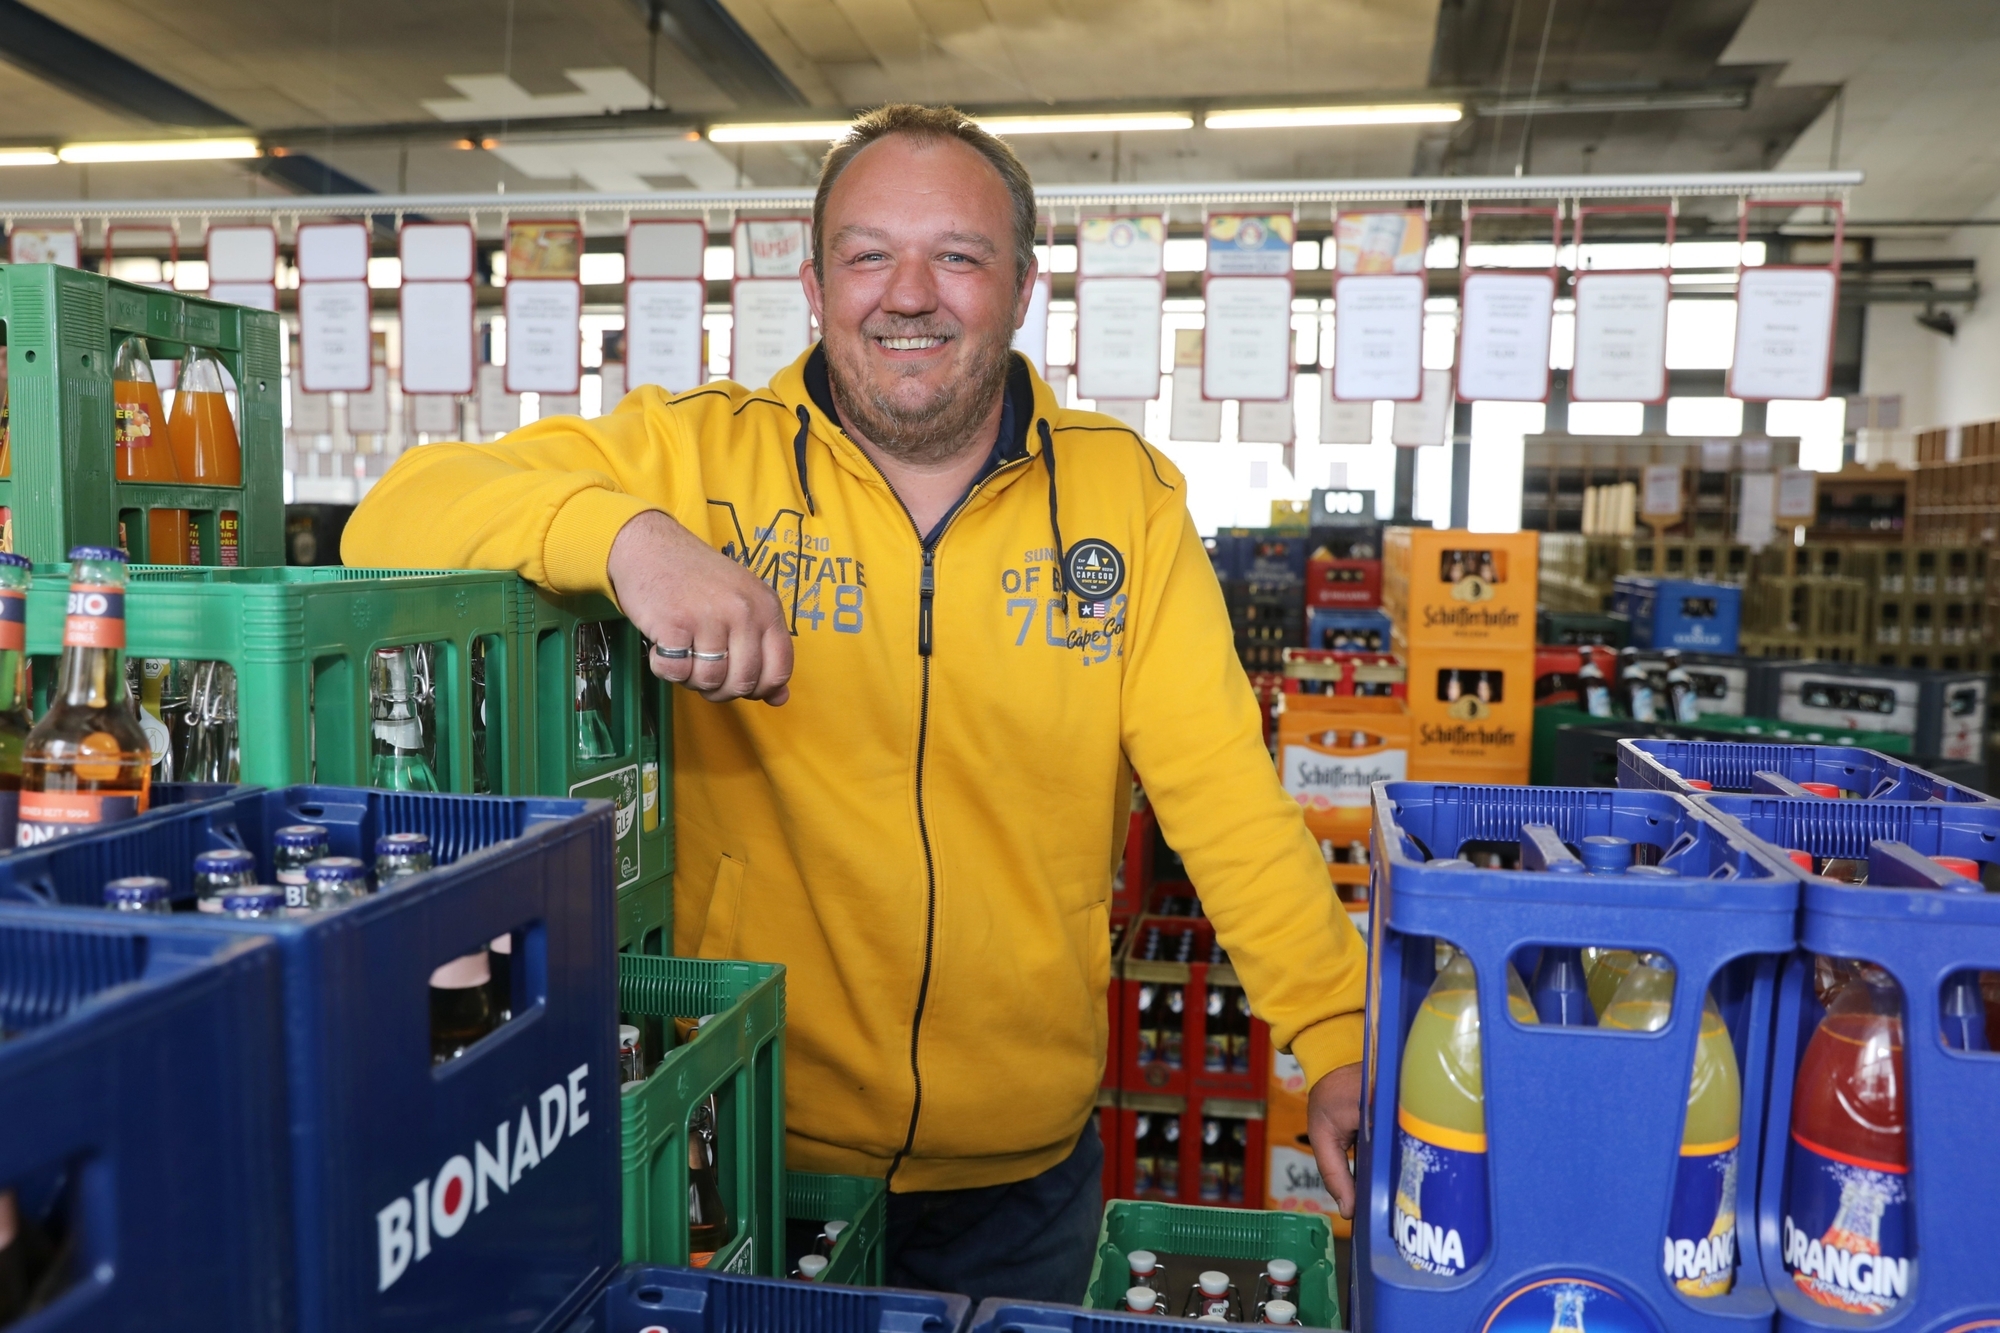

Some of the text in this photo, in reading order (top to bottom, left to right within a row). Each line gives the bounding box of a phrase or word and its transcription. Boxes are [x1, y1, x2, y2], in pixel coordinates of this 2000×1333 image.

[753, 526, 777, 542] MA
[1024, 548, 1060, 563] SUN
[778, 551, 867, 588] STATE
[1002, 567, 1041, 593] OF
[1076, 570, 1113, 580] CAPE COD
[66, 592, 109, 616] BIO
[1066, 629, 1100, 652] Cape
[285, 885, 311, 907] BI
[376, 1062, 590, 1293] BIONADE
[1783, 1214, 1909, 1298] ORANGIN
